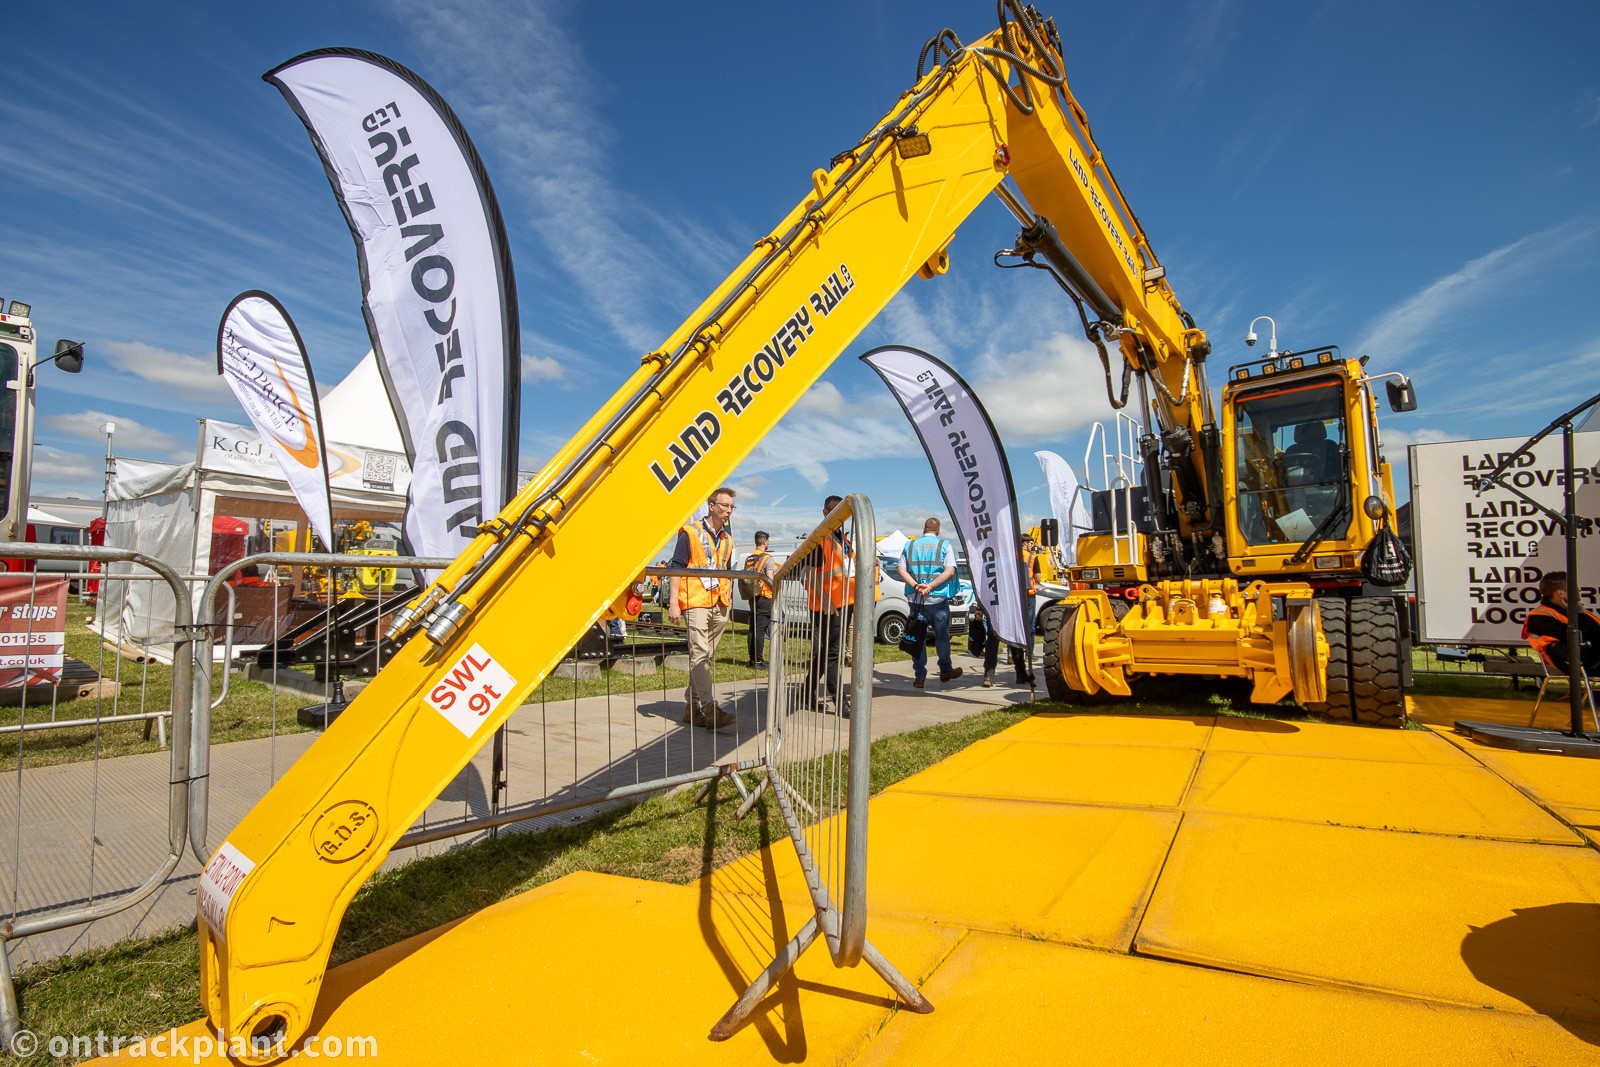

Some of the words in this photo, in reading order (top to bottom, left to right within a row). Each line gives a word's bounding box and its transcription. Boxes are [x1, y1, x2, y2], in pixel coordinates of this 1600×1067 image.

[1069, 146, 1089, 188] LAND
[1090, 184, 1123, 250] RECOVERY
[368, 126, 466, 406] RECOVERY
[253, 370, 299, 432] PRICE
[650, 411, 721, 493] LAND
[716, 305, 815, 417] RECOVERY
[809, 272, 850, 317] RAIL
[924, 377, 956, 428] RAIL
[435, 420, 484, 540] AND
[947, 429, 995, 542] RECOVERY
[1462, 450, 1536, 472] LAND
[1463, 467, 1600, 491] RCOVERY
[1465, 500, 1539, 518] LAND
[981, 546, 1000, 606] LAND
[1467, 541, 1527, 558] RAIL
[1468, 566, 1543, 584] LAND
[11, 603, 58, 622] stops
[430, 653, 492, 711] SWL
[468, 683, 502, 717] 9t
